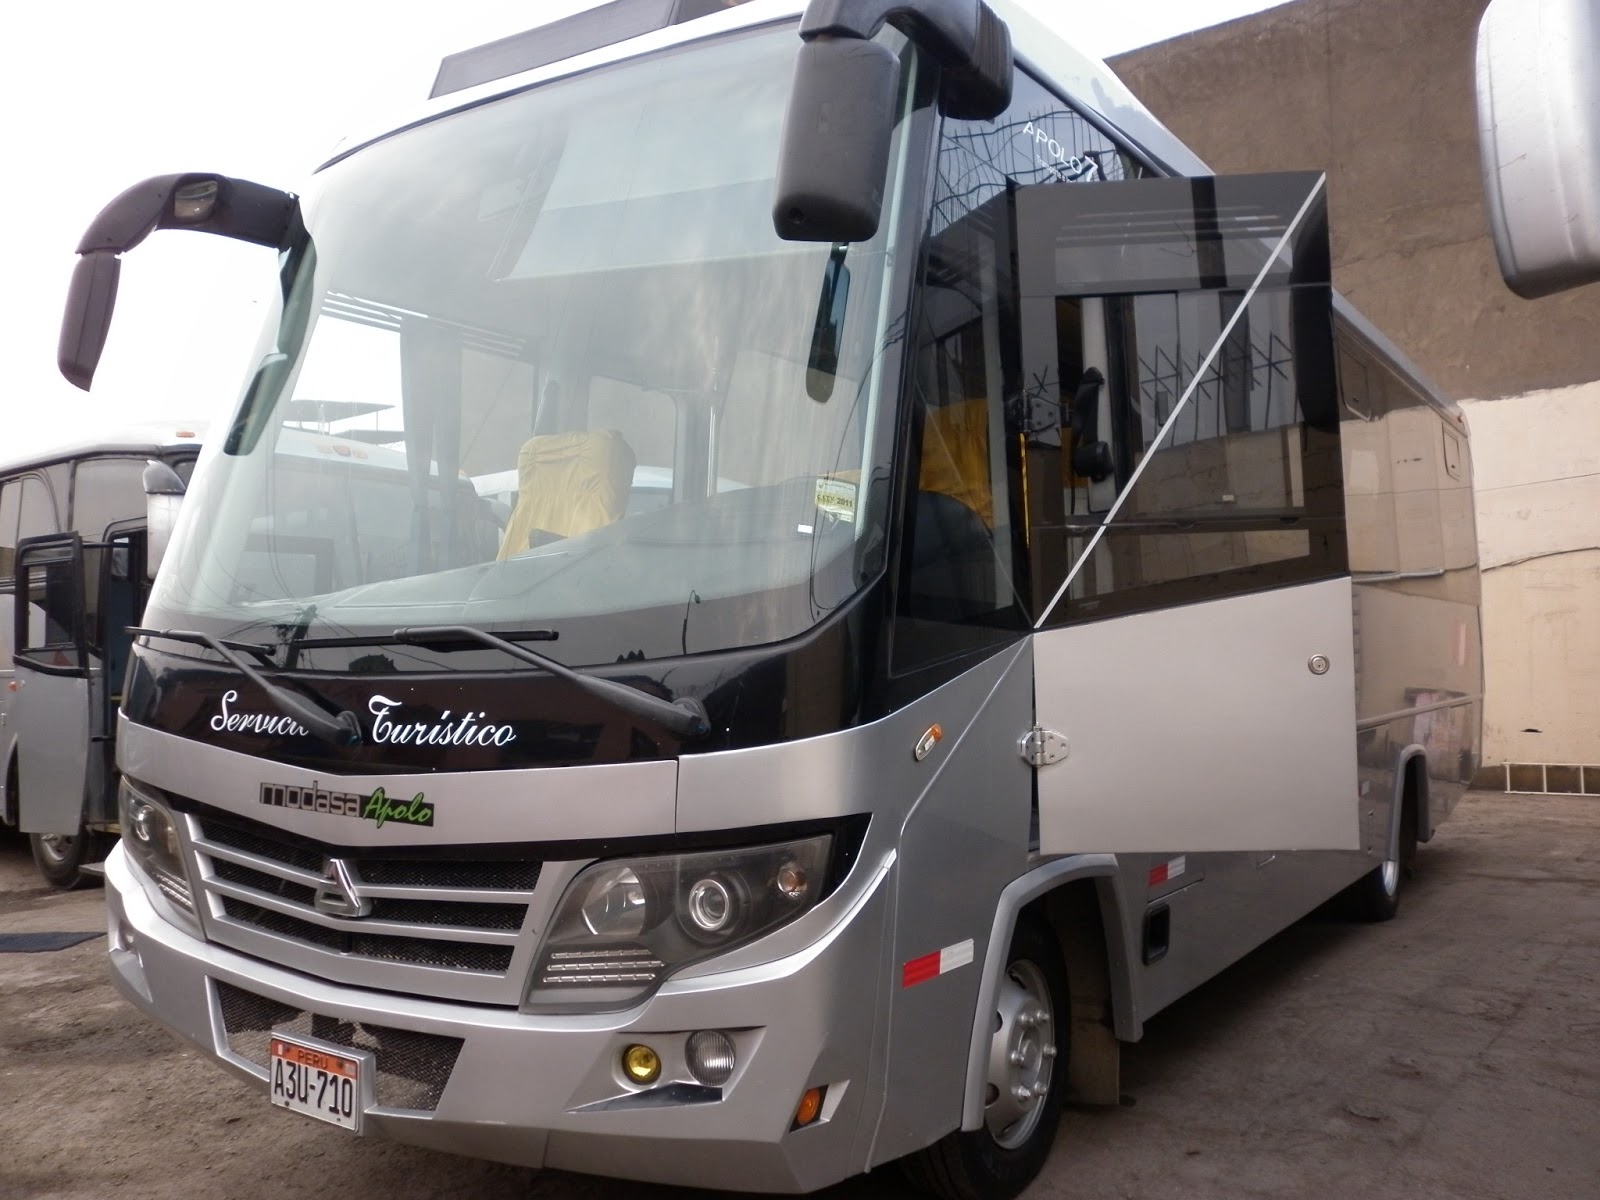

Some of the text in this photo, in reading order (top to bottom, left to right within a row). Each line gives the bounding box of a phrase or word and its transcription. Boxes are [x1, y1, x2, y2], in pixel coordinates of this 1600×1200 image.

[1022, 121, 1082, 174] APOLO
[368, 694, 517, 747] Turístico
[260, 780, 432, 829] modasa Apolo
[298, 1049, 328, 1069] PERU
[274, 1057, 353, 1118] A3U-710
